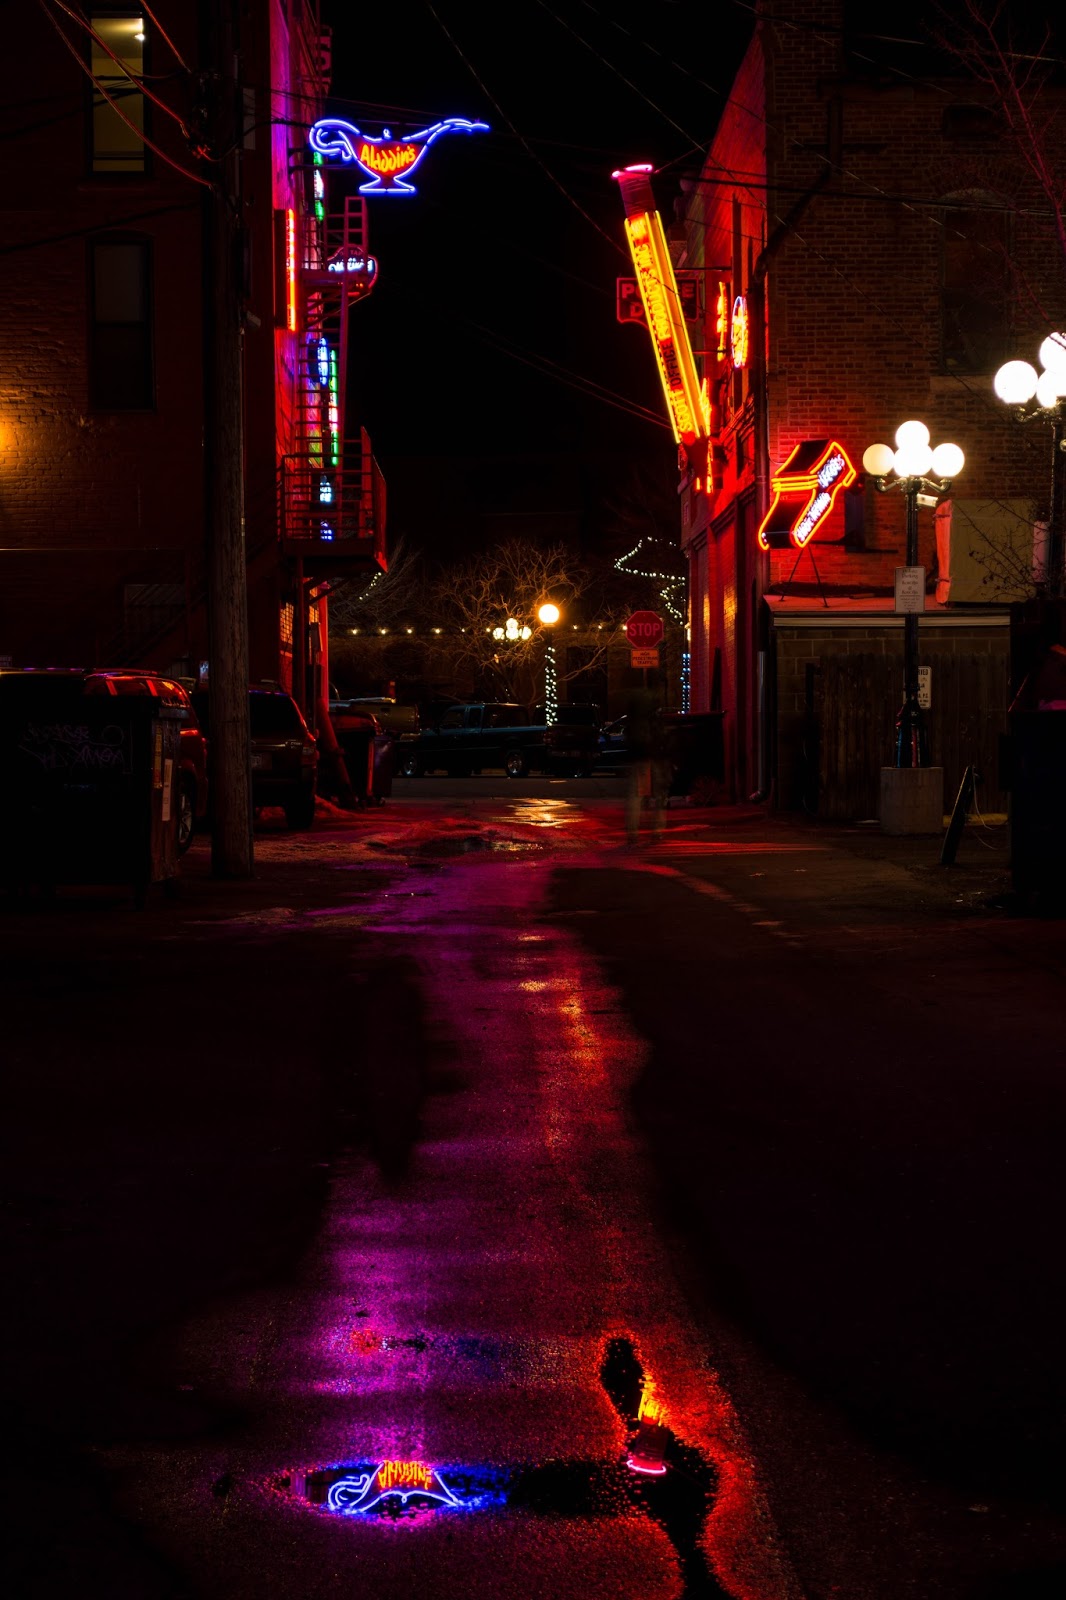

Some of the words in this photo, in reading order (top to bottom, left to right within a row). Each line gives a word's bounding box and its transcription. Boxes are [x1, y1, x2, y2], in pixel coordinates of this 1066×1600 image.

[642, 268, 671, 340] PRODUCTS
[662, 342, 682, 386] OFFICE
[670, 389, 693, 432] SCOTT
[630, 623, 660, 637] STOP
